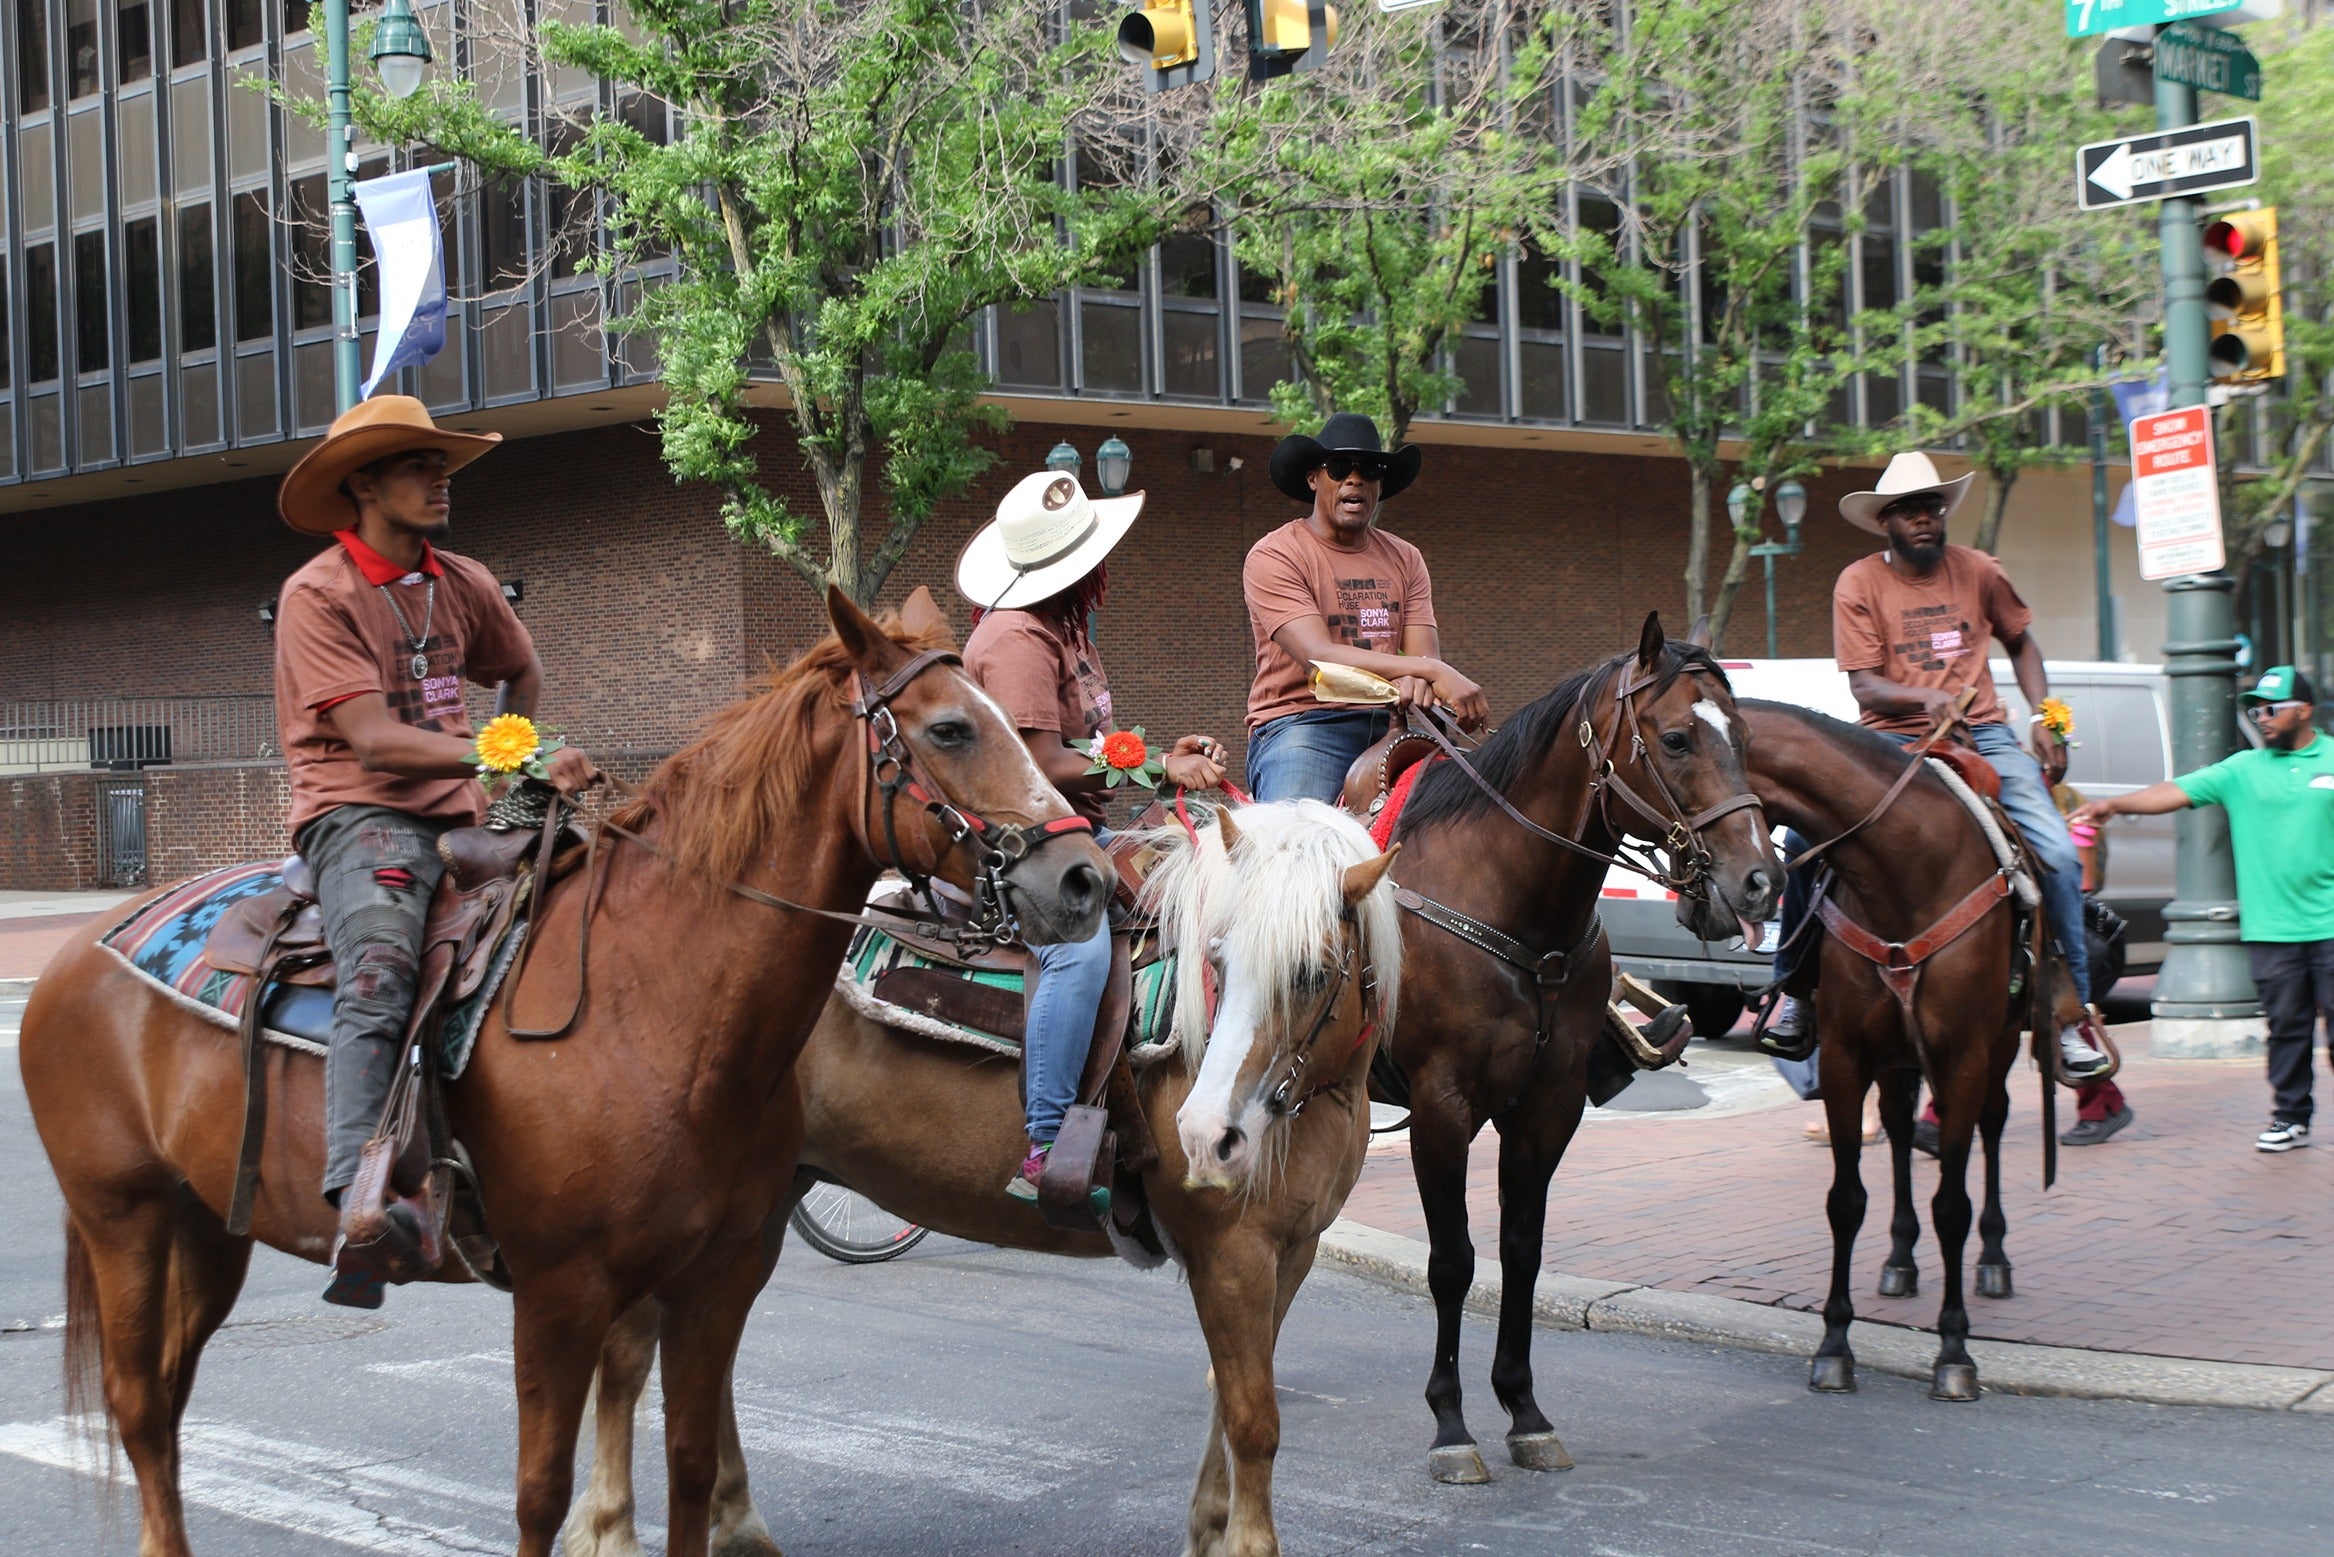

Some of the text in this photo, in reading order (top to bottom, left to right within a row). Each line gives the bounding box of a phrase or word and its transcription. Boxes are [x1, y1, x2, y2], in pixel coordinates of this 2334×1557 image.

[2163, 0, 2241, 17] STRE
[2159, 41, 2230, 90] MARKET
[2130, 142, 2235, 182] ONE WAY
[2152, 417, 2187, 436] SNOW
[2136, 431, 2205, 456] EMERGENCY
[2152, 450, 2192, 469] ROUTE
[1336, 590, 1388, 601] DCLARATION
[1338, 600, 1361, 610] HUSE
[1360, 608, 1389, 618] SONYA
[1361, 617, 1390, 627] CLARK
[422, 675, 458, 690] SONYA
[425, 687, 459, 703] CLARK
